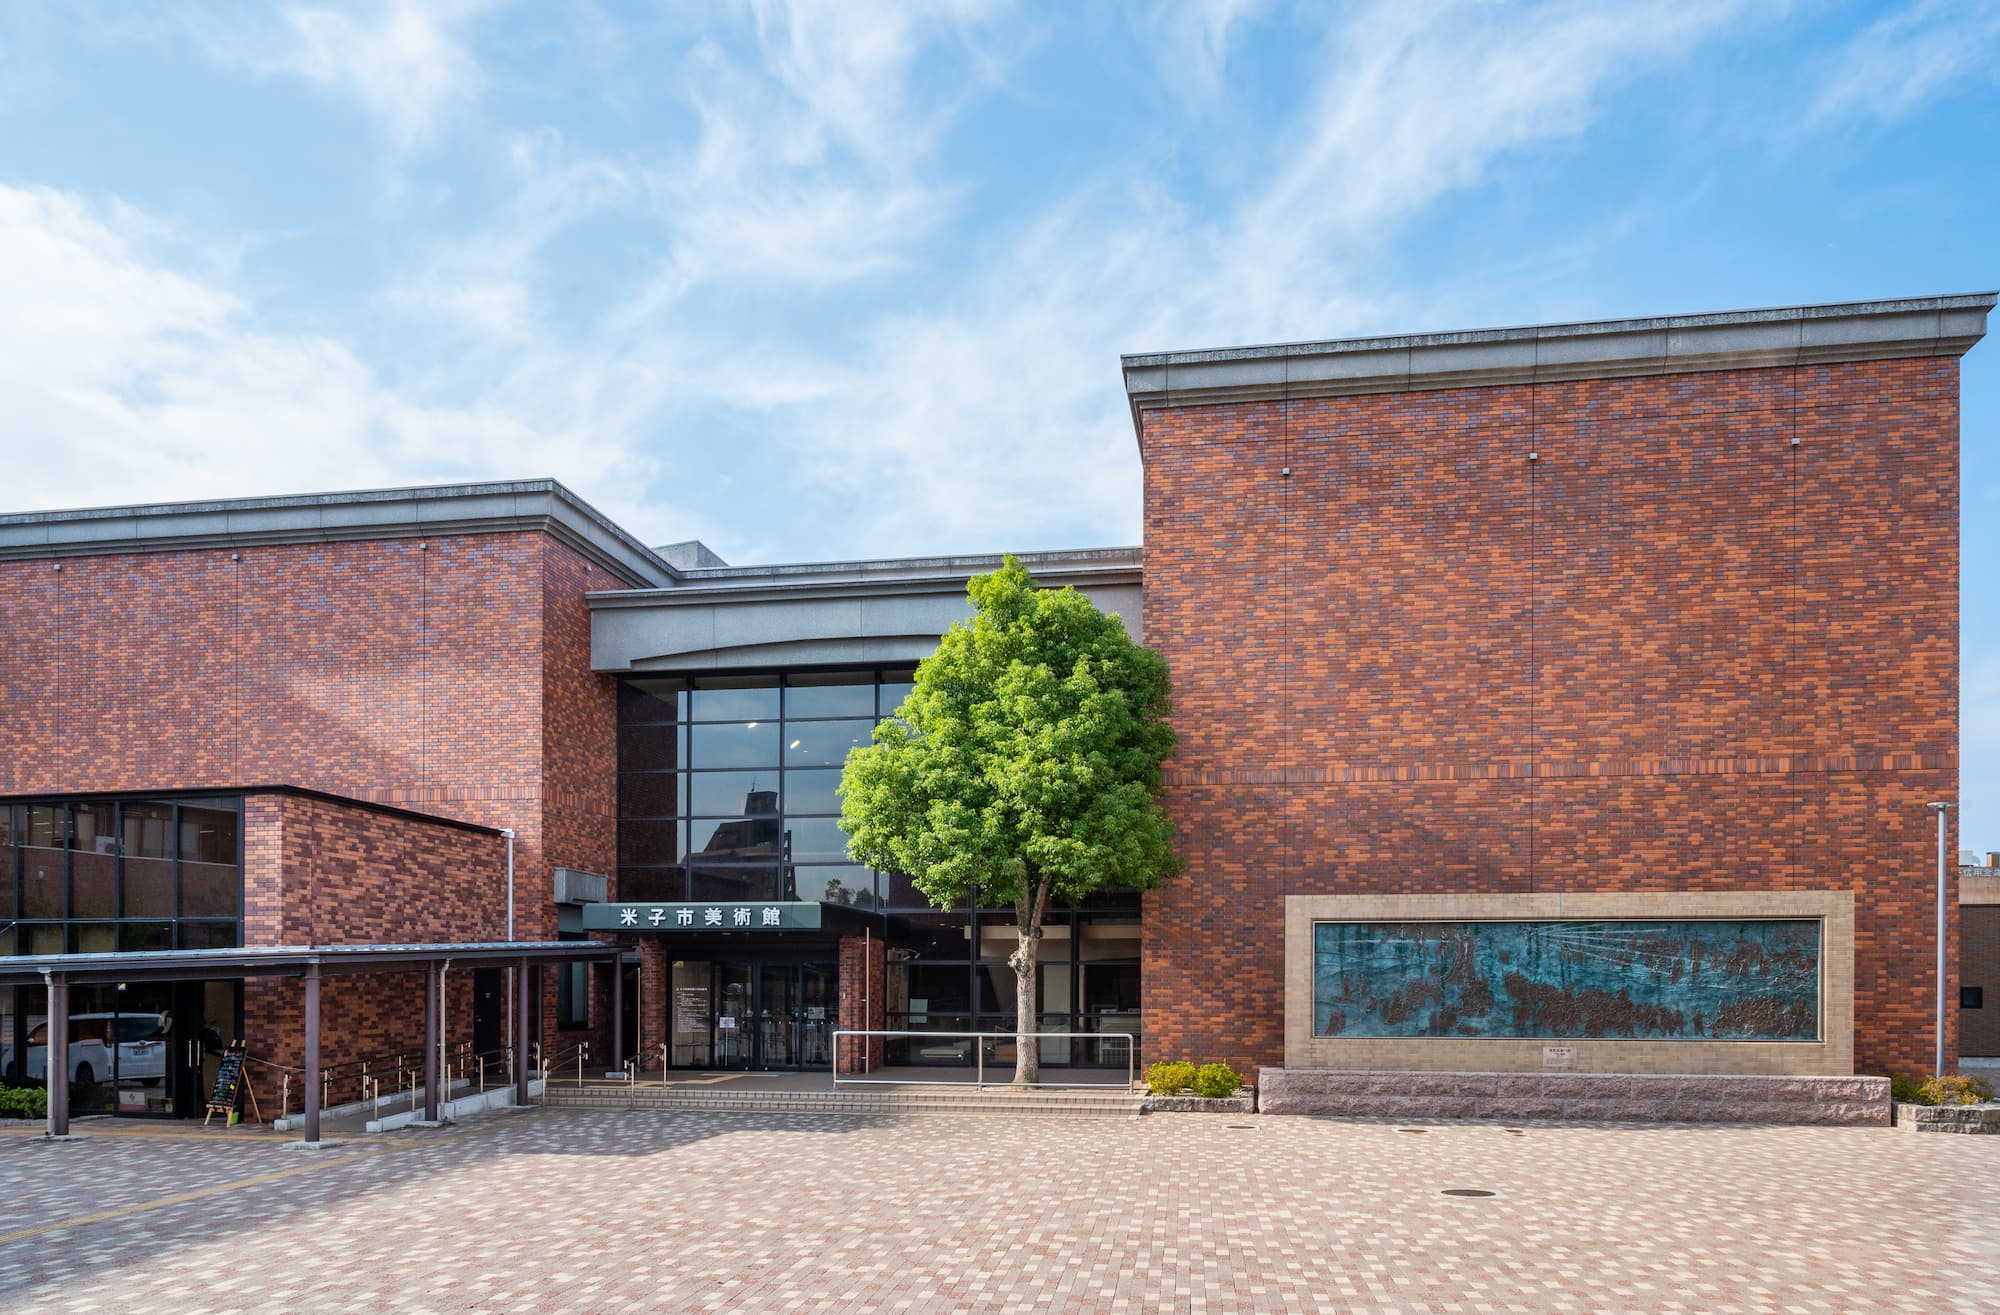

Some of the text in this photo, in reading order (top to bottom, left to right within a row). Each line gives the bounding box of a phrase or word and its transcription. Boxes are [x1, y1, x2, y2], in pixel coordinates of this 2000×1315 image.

[620, 907, 780, 926] 米子市美術館
